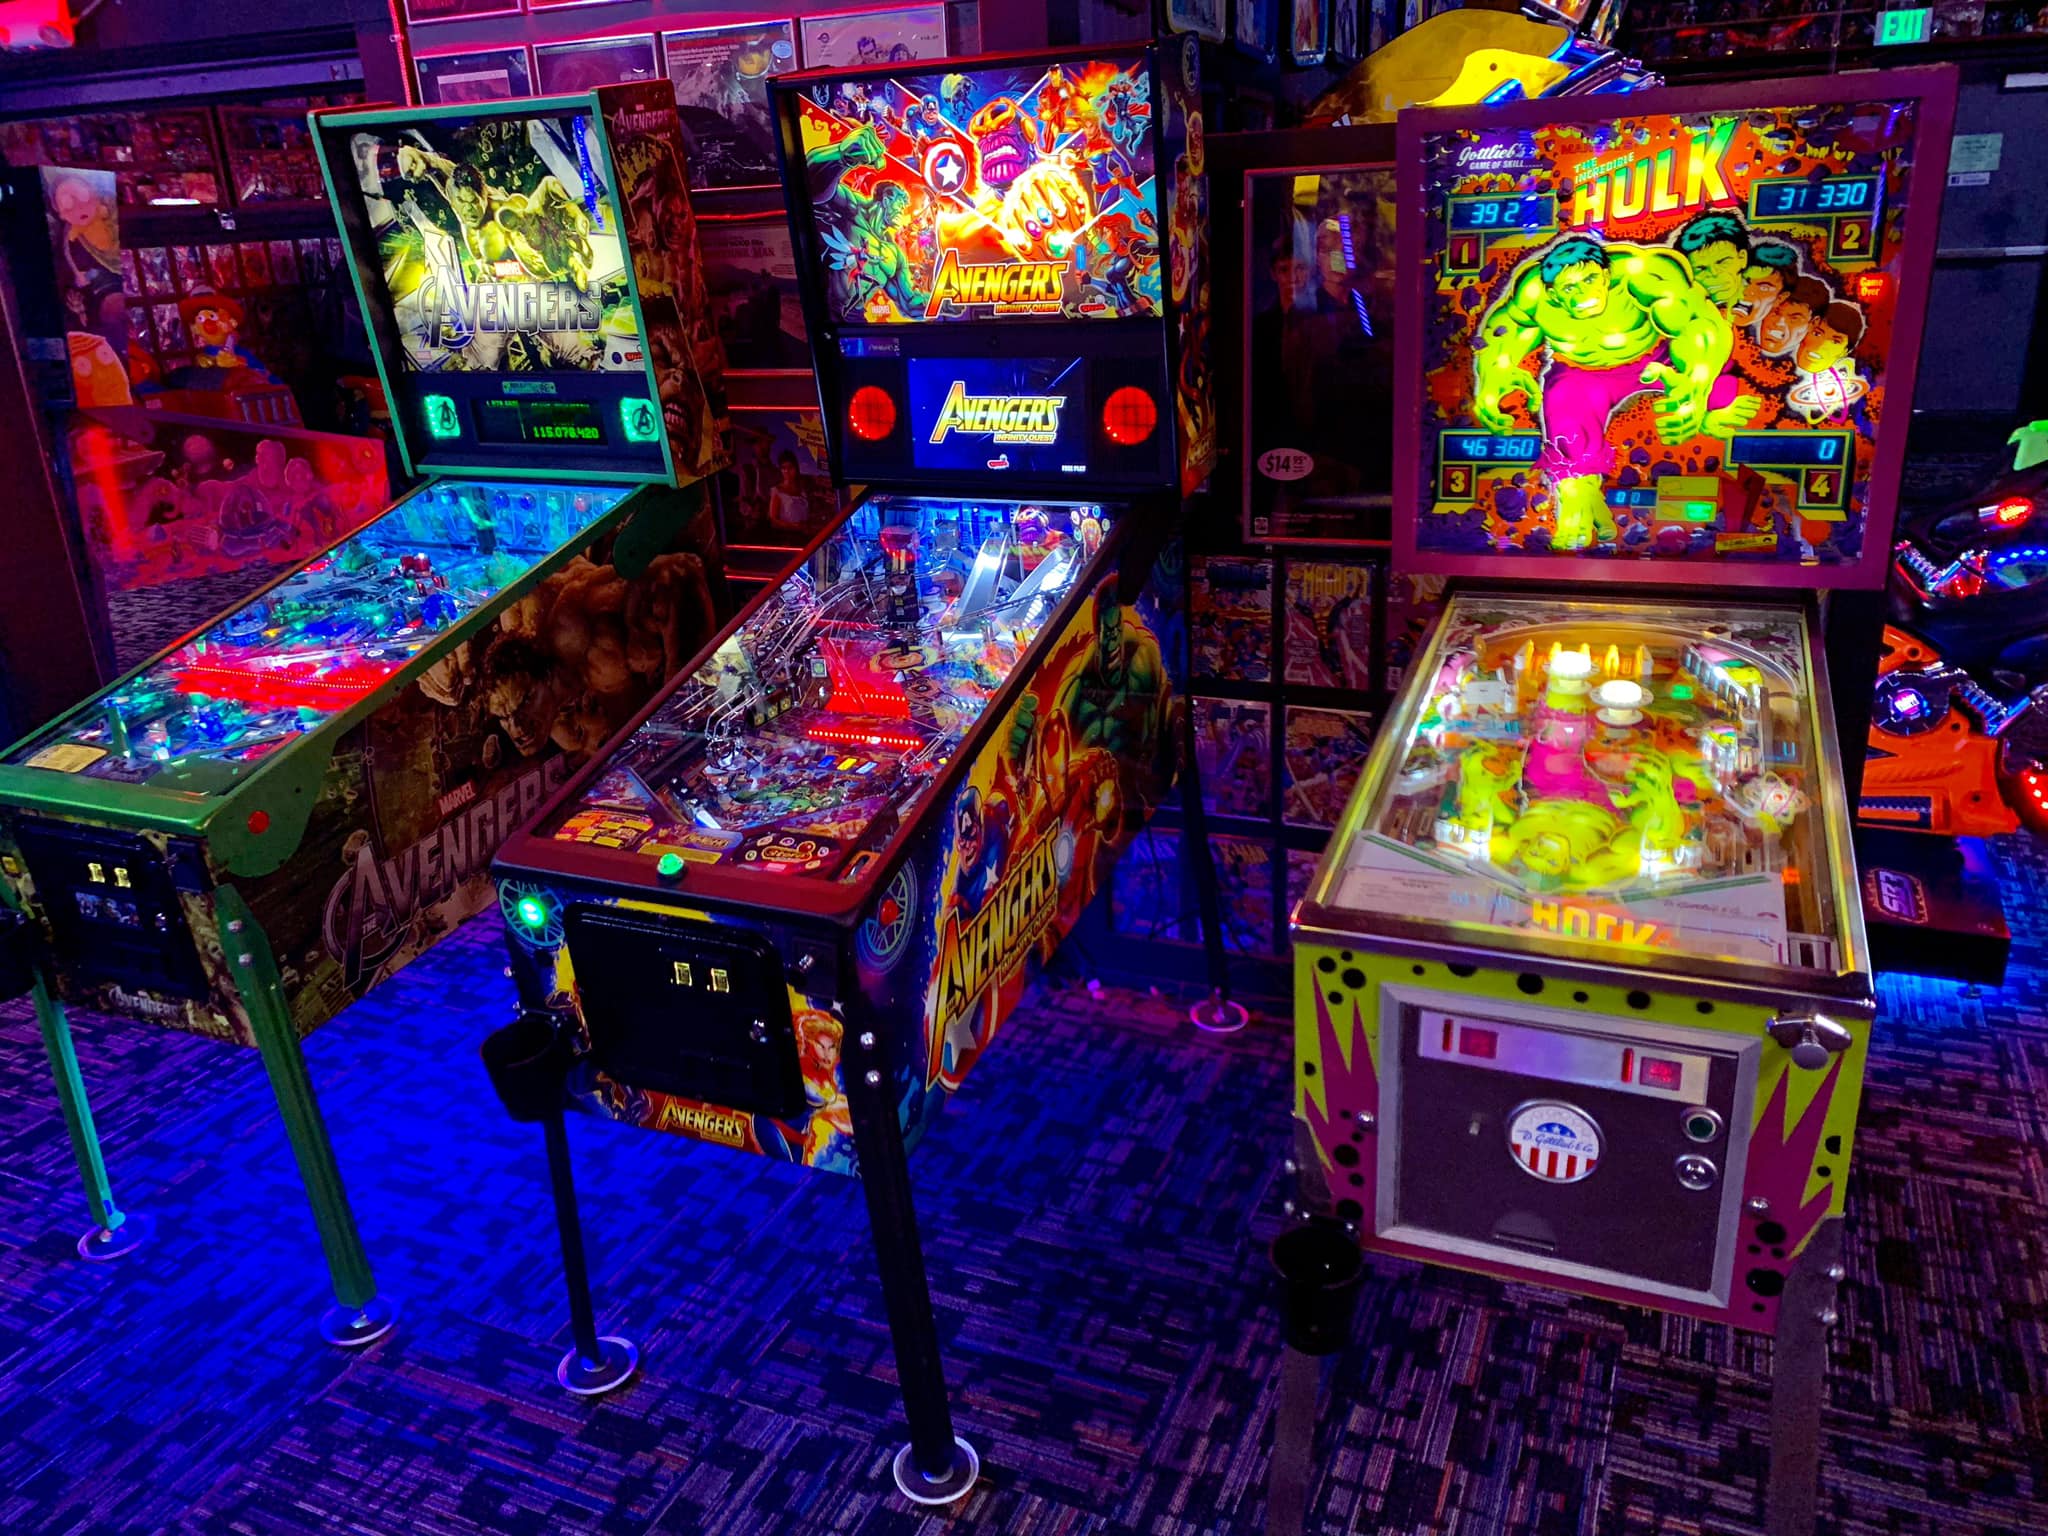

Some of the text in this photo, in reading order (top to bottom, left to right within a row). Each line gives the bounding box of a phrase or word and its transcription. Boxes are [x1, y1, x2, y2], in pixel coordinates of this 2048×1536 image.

[1881, 9, 1927, 43] EXIT
[1469, 161, 1490, 170] GAME
[1491, 161, 1502, 170] OF
[1573, 118, 1740, 231] HULK
[1574, 157, 1598, 173] THE
[1575, 151, 1635, 183] INCREDIBLE
[1842, 223, 1861, 249] 2
[1460, 241, 1470, 264] 1
[925, 249, 1069, 318] AVENGERS
[1860, 277, 1883, 287] Game
[1861, 286, 1880, 296] Over
[418, 265, 602, 349] AVENGERS
[996, 303, 1061, 313] INFINITY QUEST
[930, 382, 1063, 442] AVENGERS
[1493, 438, 1534, 457] 360
[1818, 439, 1837, 460] 0
[1450, 471, 1466, 493] 3
[1810, 474, 1831, 498] 4
[440, 781, 475, 815] MARVEL
[323, 753, 568, 990] AVENGERS
[926, 817, 1060, 1092] AVENGERS
[656, 1096, 746, 1138] AVENGERS
